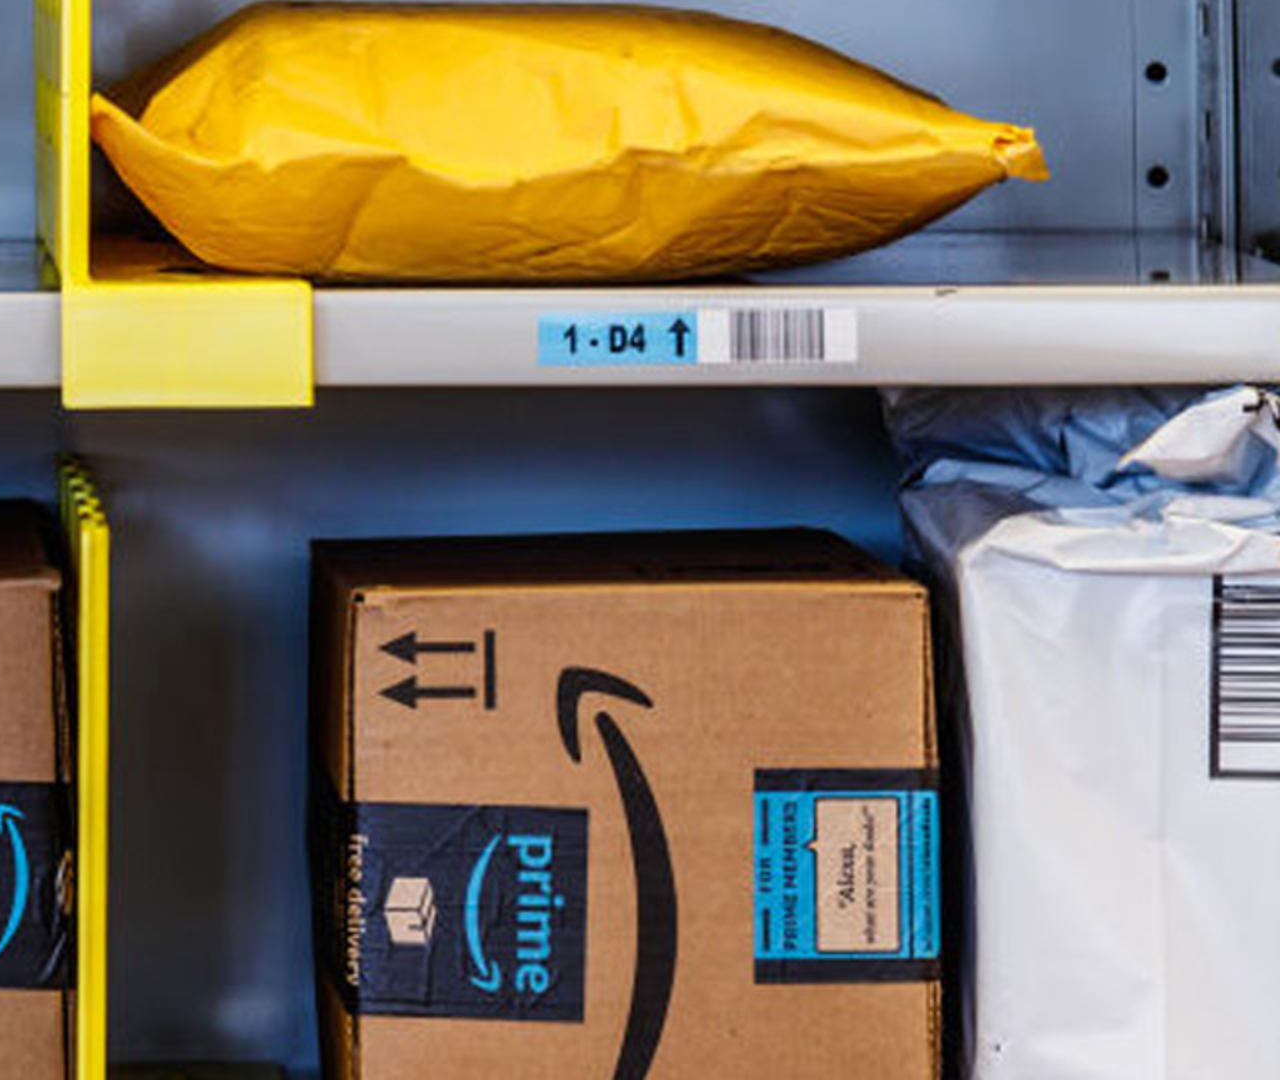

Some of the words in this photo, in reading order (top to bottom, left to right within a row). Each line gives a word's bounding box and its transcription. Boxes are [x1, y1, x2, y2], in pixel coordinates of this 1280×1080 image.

[610, 325, 646, 354] D4
[348, 834, 369, 880] free
[781, 801, 798, 888] MEMBERS
[760, 857, 771, 893] FOR
[345, 888, 367, 986] delivery
[508, 834, 564, 994] prime
[782, 894, 797, 950] PRIME
